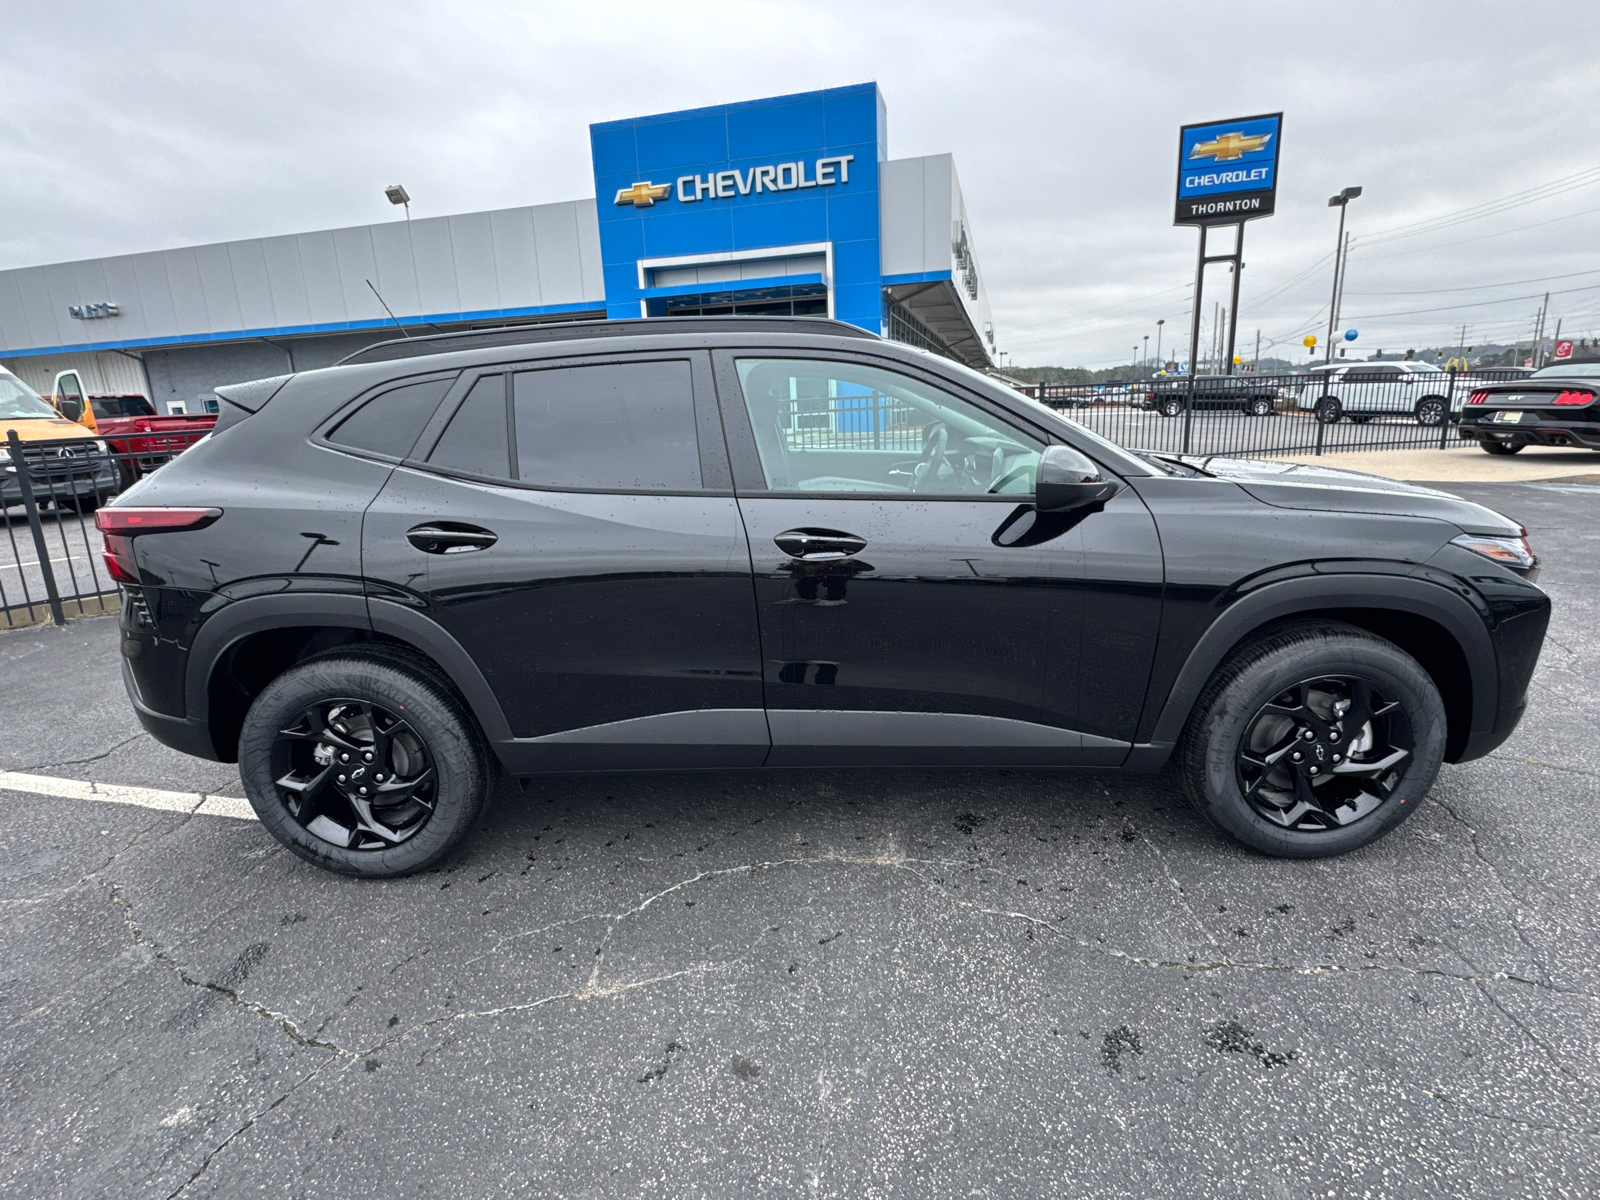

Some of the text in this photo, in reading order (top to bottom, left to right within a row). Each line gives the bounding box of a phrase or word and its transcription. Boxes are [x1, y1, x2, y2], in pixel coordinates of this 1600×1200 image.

[677, 155, 854, 202] CHEVROLET
[1187, 168, 1268, 187] CHEVROLET
[1191, 199, 1259, 214] THORNTON
[69, 302, 112, 319] PARTS
